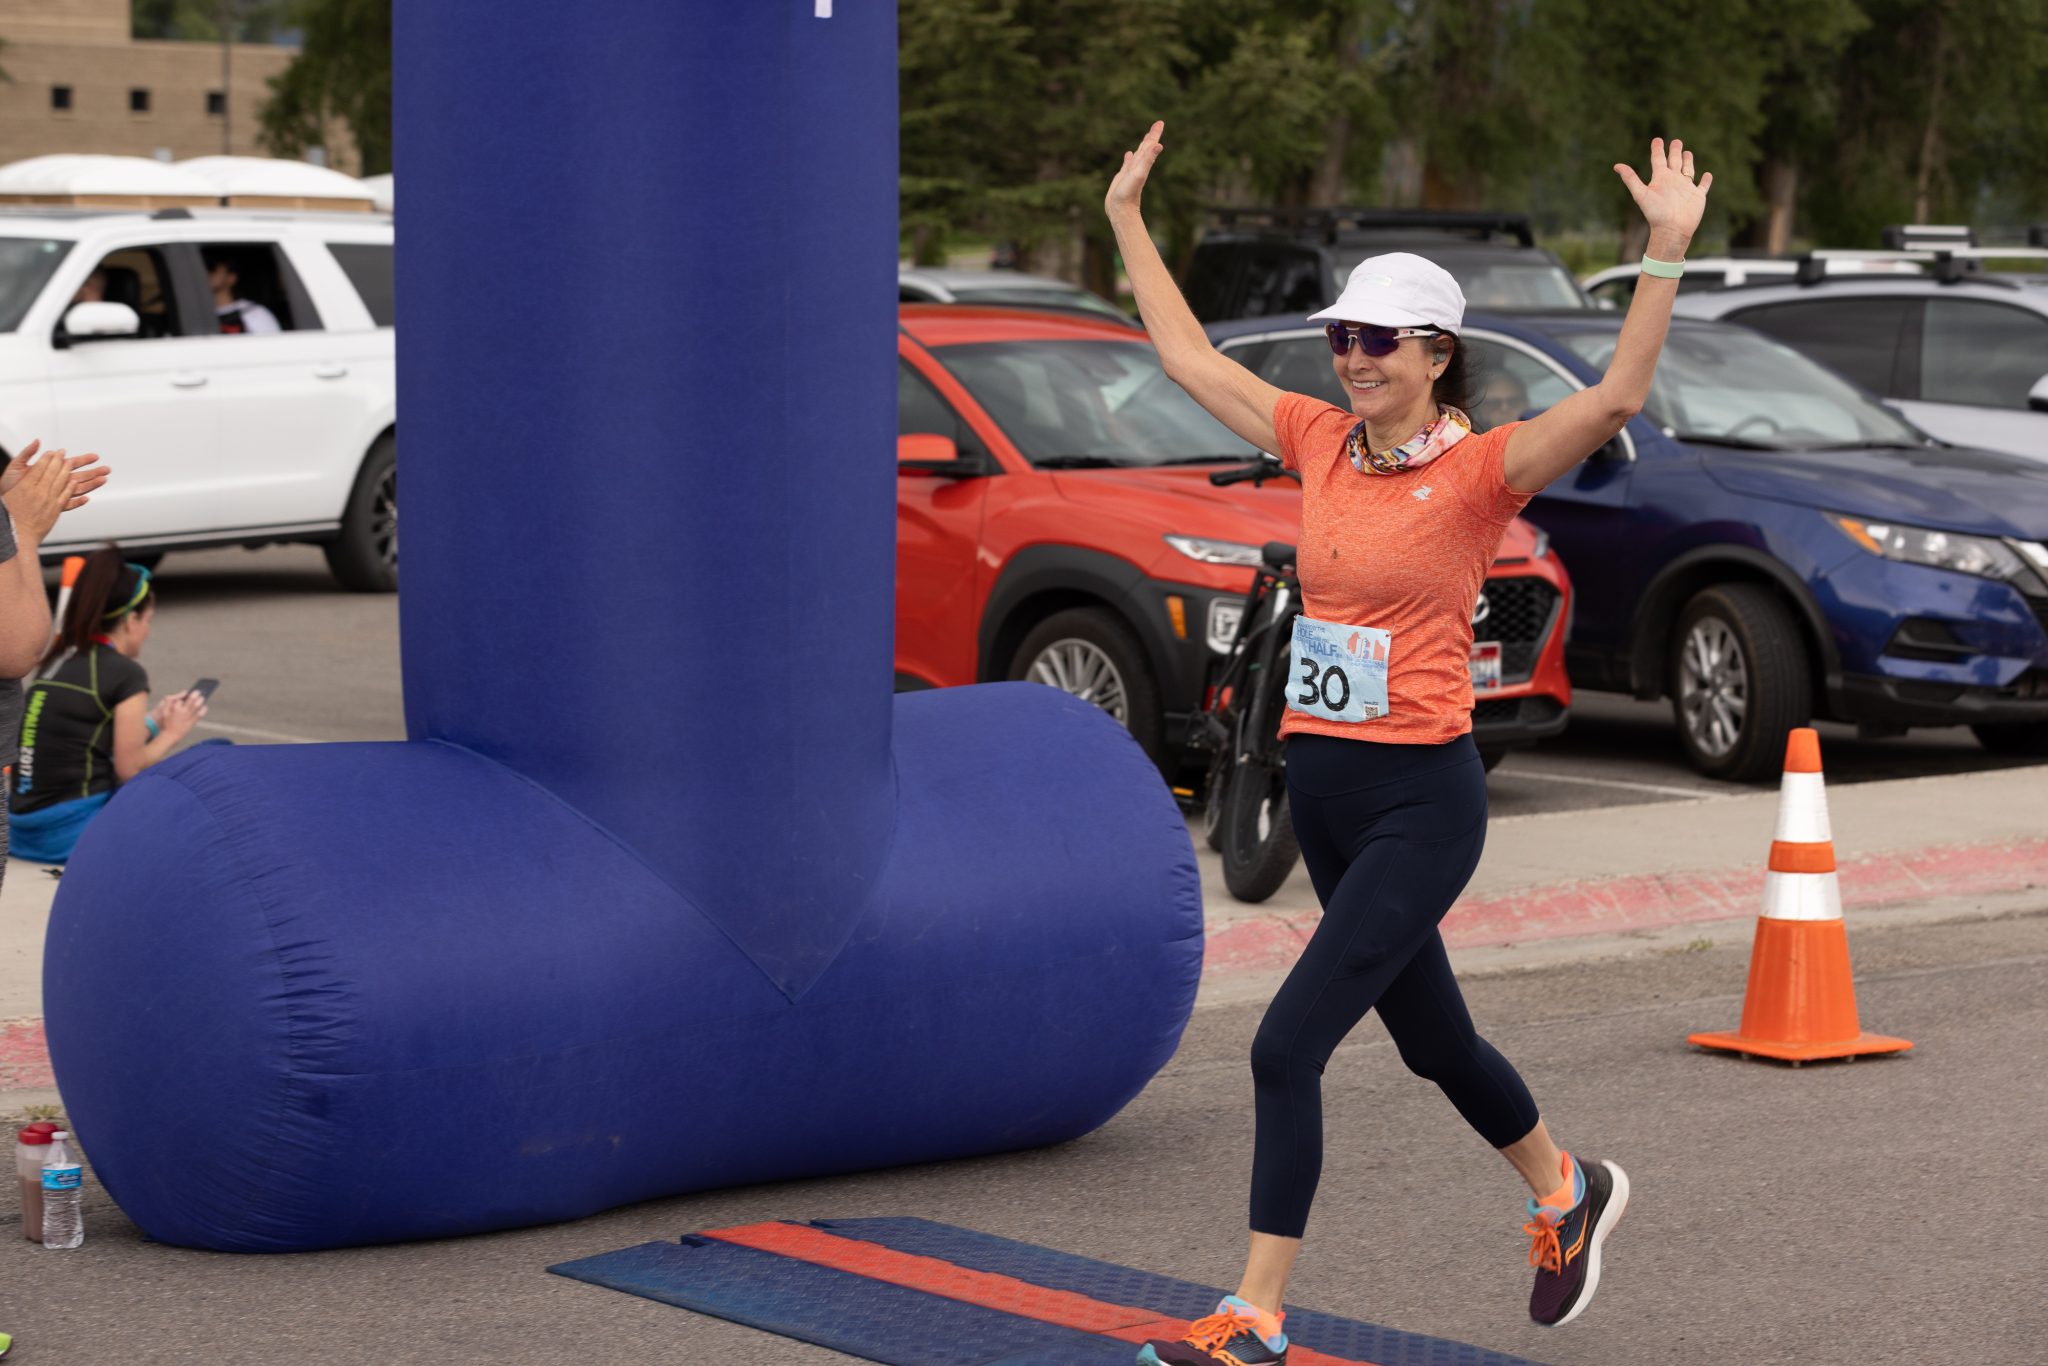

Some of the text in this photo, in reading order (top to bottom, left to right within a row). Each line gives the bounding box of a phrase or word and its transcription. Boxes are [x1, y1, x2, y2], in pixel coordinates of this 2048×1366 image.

[1308, 640, 1337, 656] HALF
[1298, 657, 1350, 712] 30
[19, 747, 34, 777] 2017
